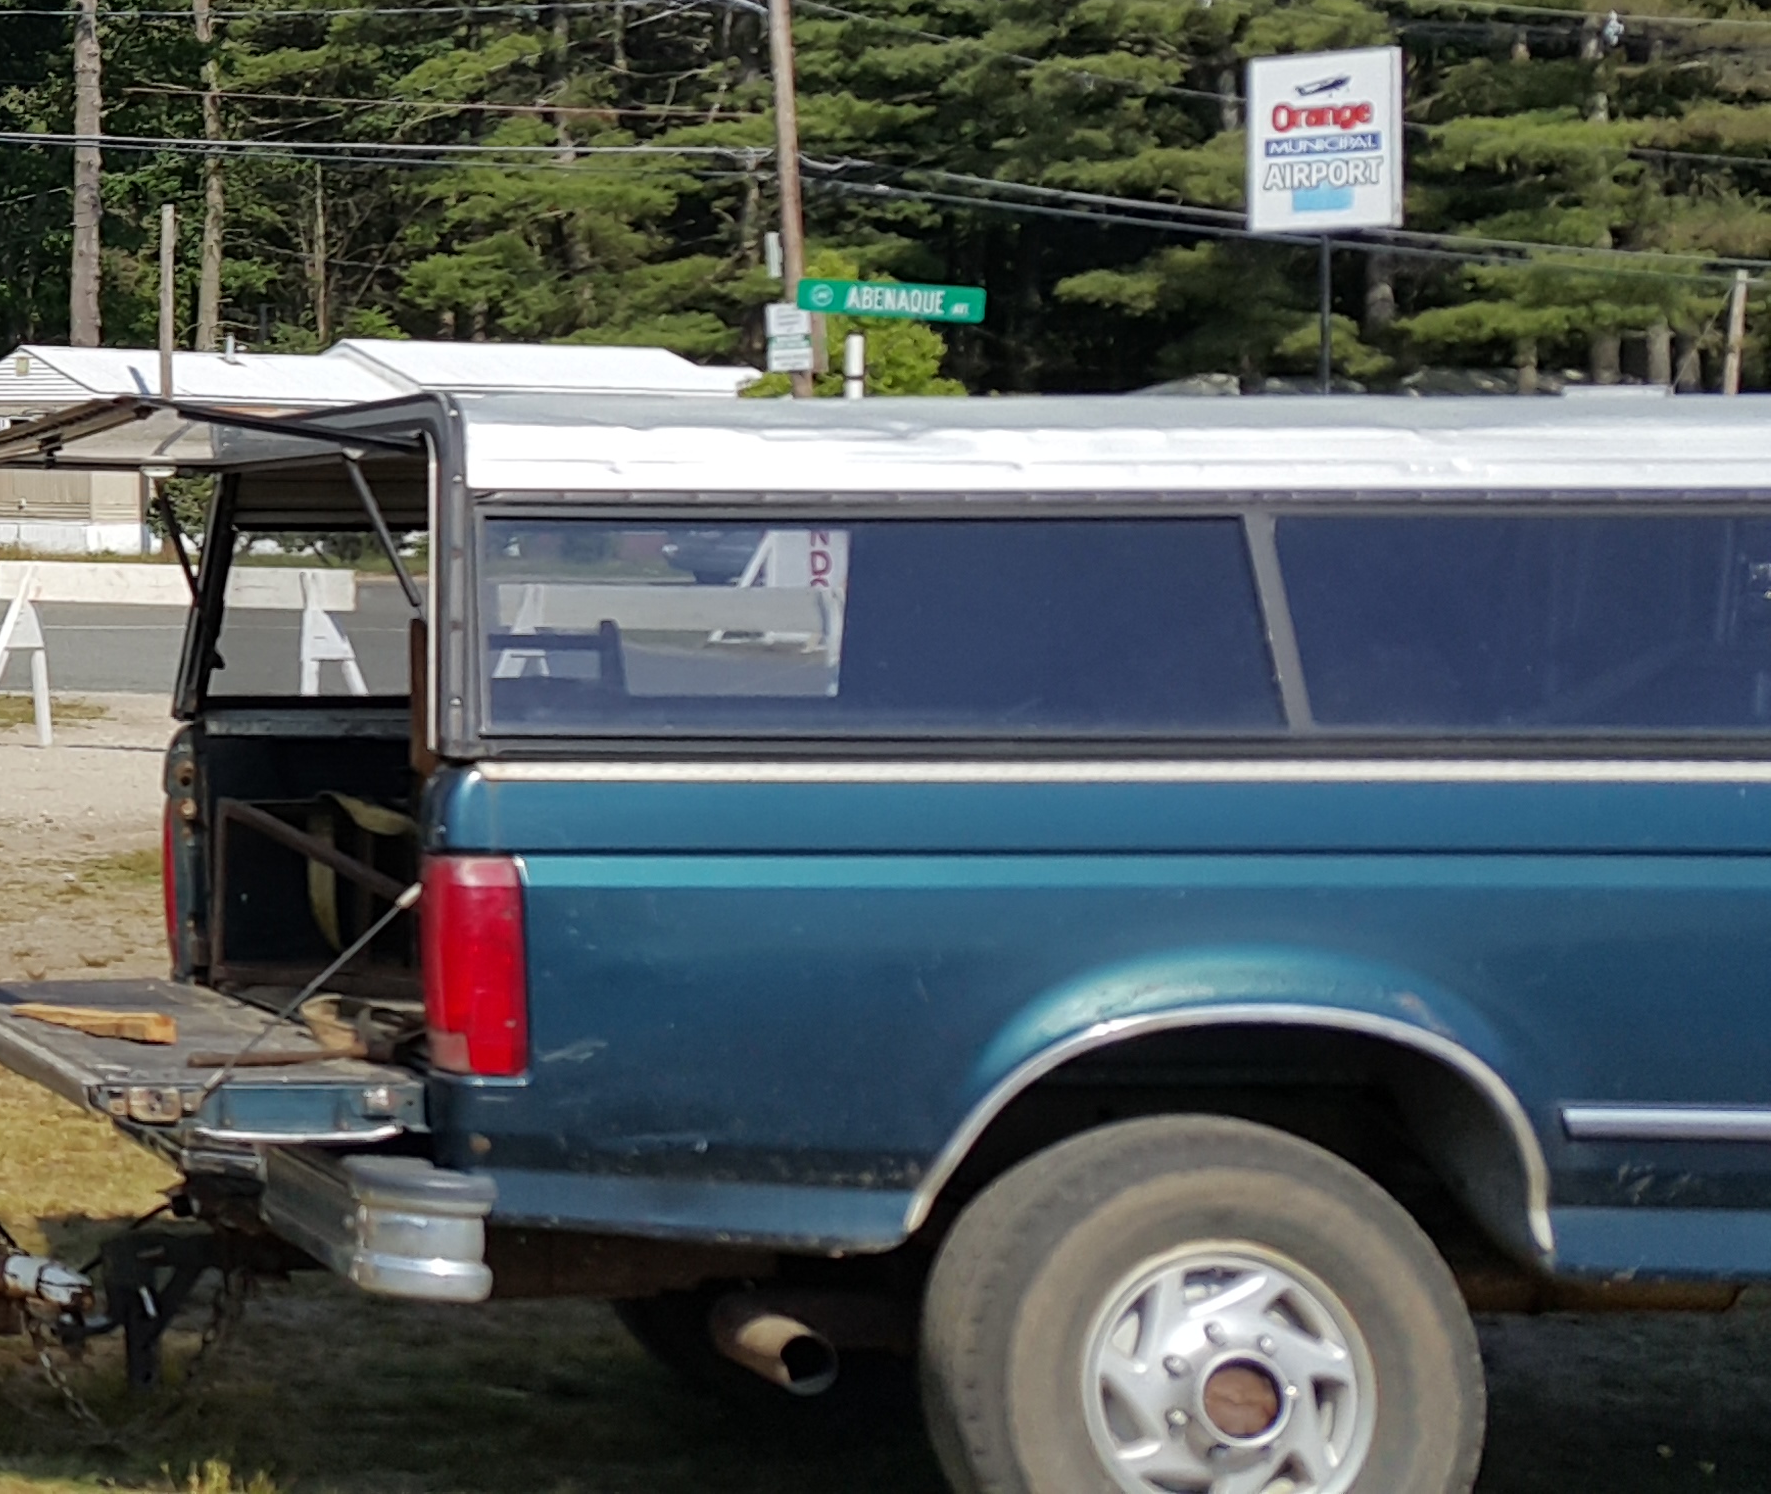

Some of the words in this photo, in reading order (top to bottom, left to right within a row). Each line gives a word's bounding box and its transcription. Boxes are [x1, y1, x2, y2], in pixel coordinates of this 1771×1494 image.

[1272, 103, 1372, 132] Orange
[1267, 133, 1378, 155] MUNICIPAL
[1264, 157, 1383, 190] AIRPORT
[845, 284, 945, 315] ABENAQUE
